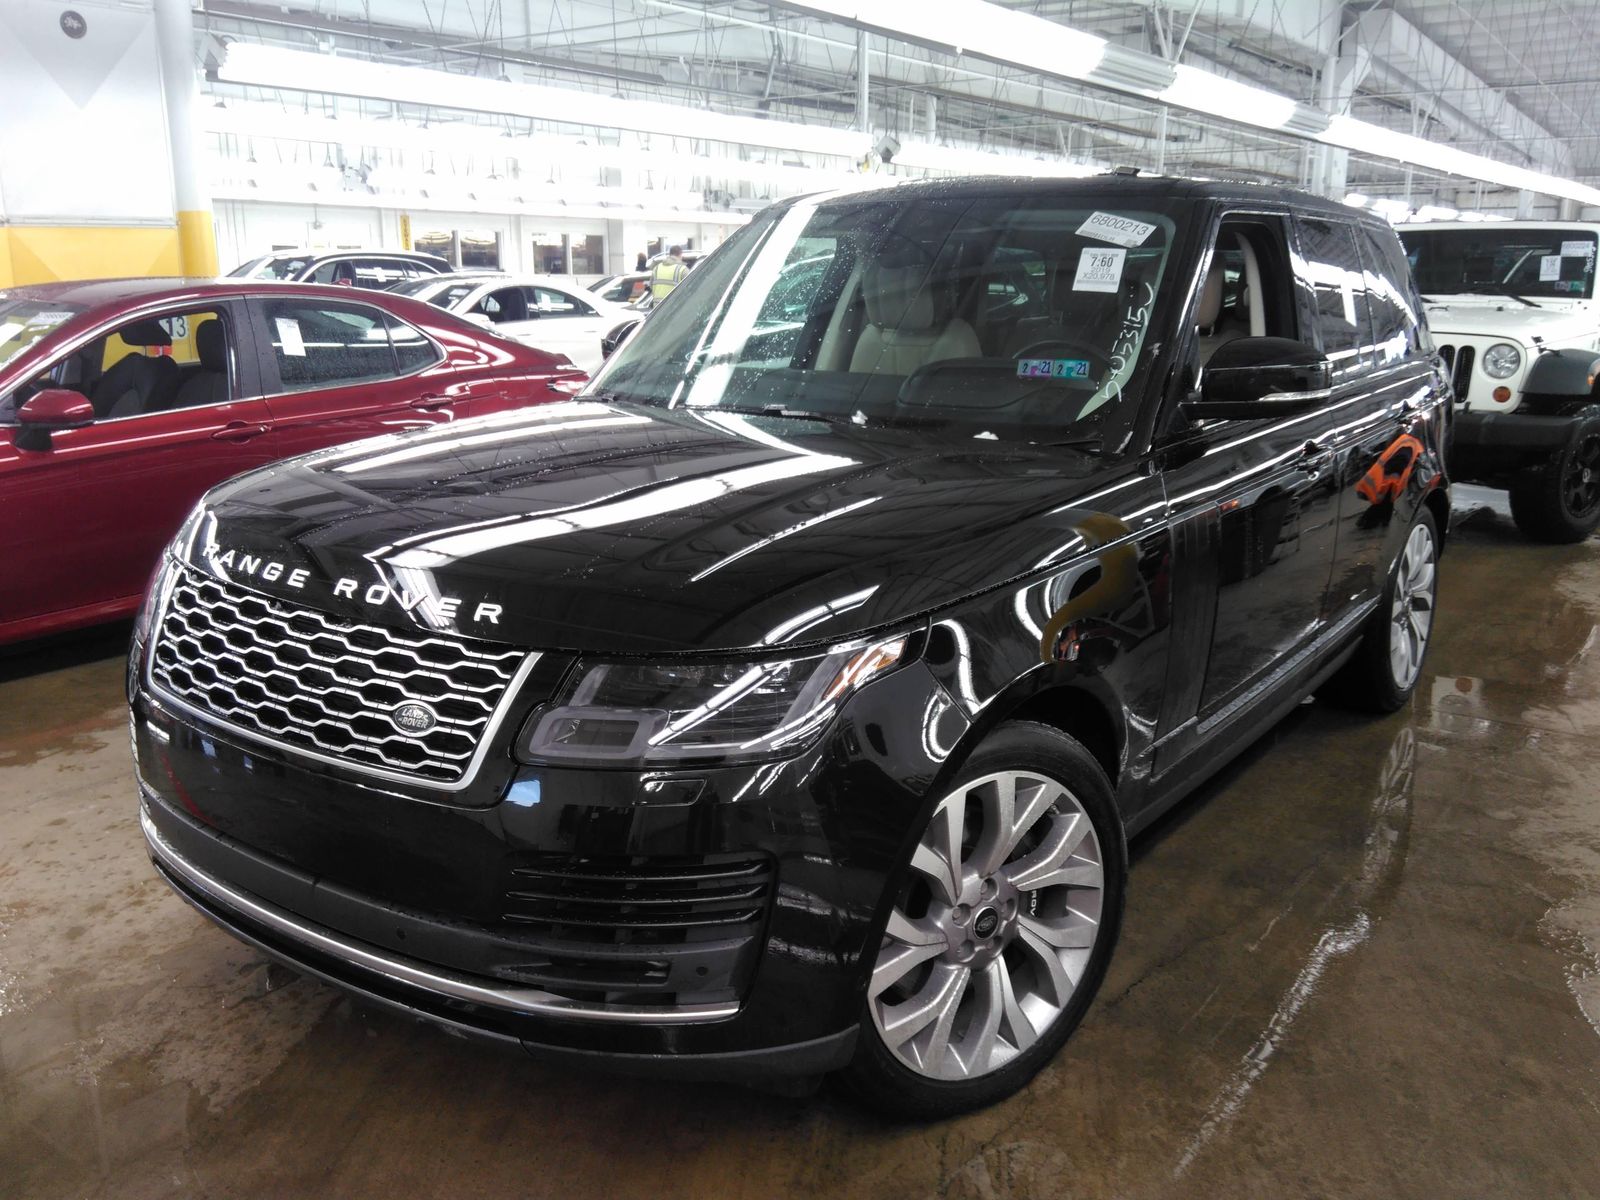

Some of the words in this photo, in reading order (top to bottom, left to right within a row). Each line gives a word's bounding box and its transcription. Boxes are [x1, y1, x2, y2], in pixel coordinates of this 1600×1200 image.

[1090, 214, 1149, 236] 6800213
[1040, 361, 1051, 374] 21
[1076, 362, 1087, 376] 21
[202, 542, 311, 588] RANGE
[333, 577, 503, 624] ROVER
[401, 716, 429, 729] ROVER
